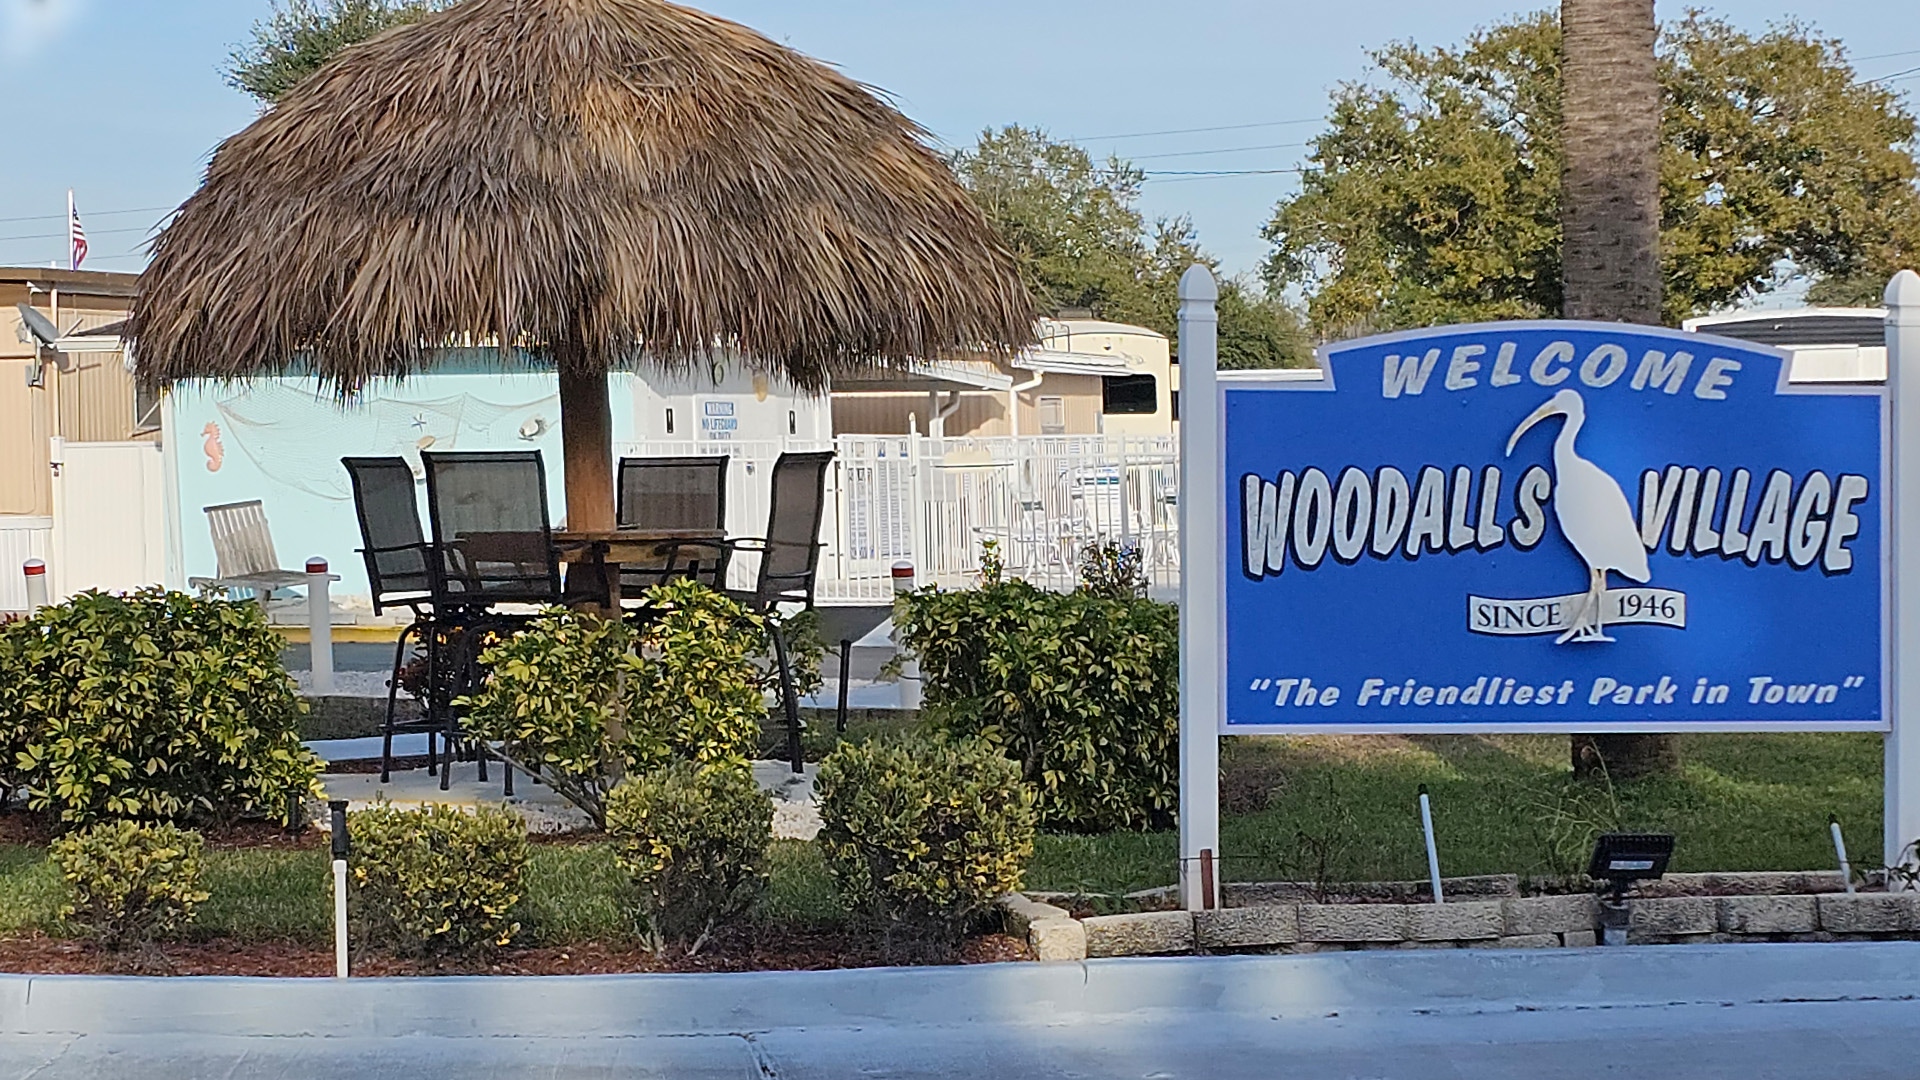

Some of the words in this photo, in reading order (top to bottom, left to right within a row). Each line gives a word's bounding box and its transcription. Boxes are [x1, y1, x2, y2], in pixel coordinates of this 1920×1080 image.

[1382, 341, 1742, 400] WELCOME
[702, 418, 709, 430] NO
[711, 418, 737, 430] LIFEGUARD
[1242, 465, 1551, 579] WOODALLS
[1640, 465, 1868, 574] VILLAGE
[1477, 602, 1562, 628] SINCE
[1618, 594, 1677, 619] 1946
[1357, 676, 1574, 706] Friendliest
[1588, 676, 1678, 705] Park
[1692, 678, 1729, 704] in
